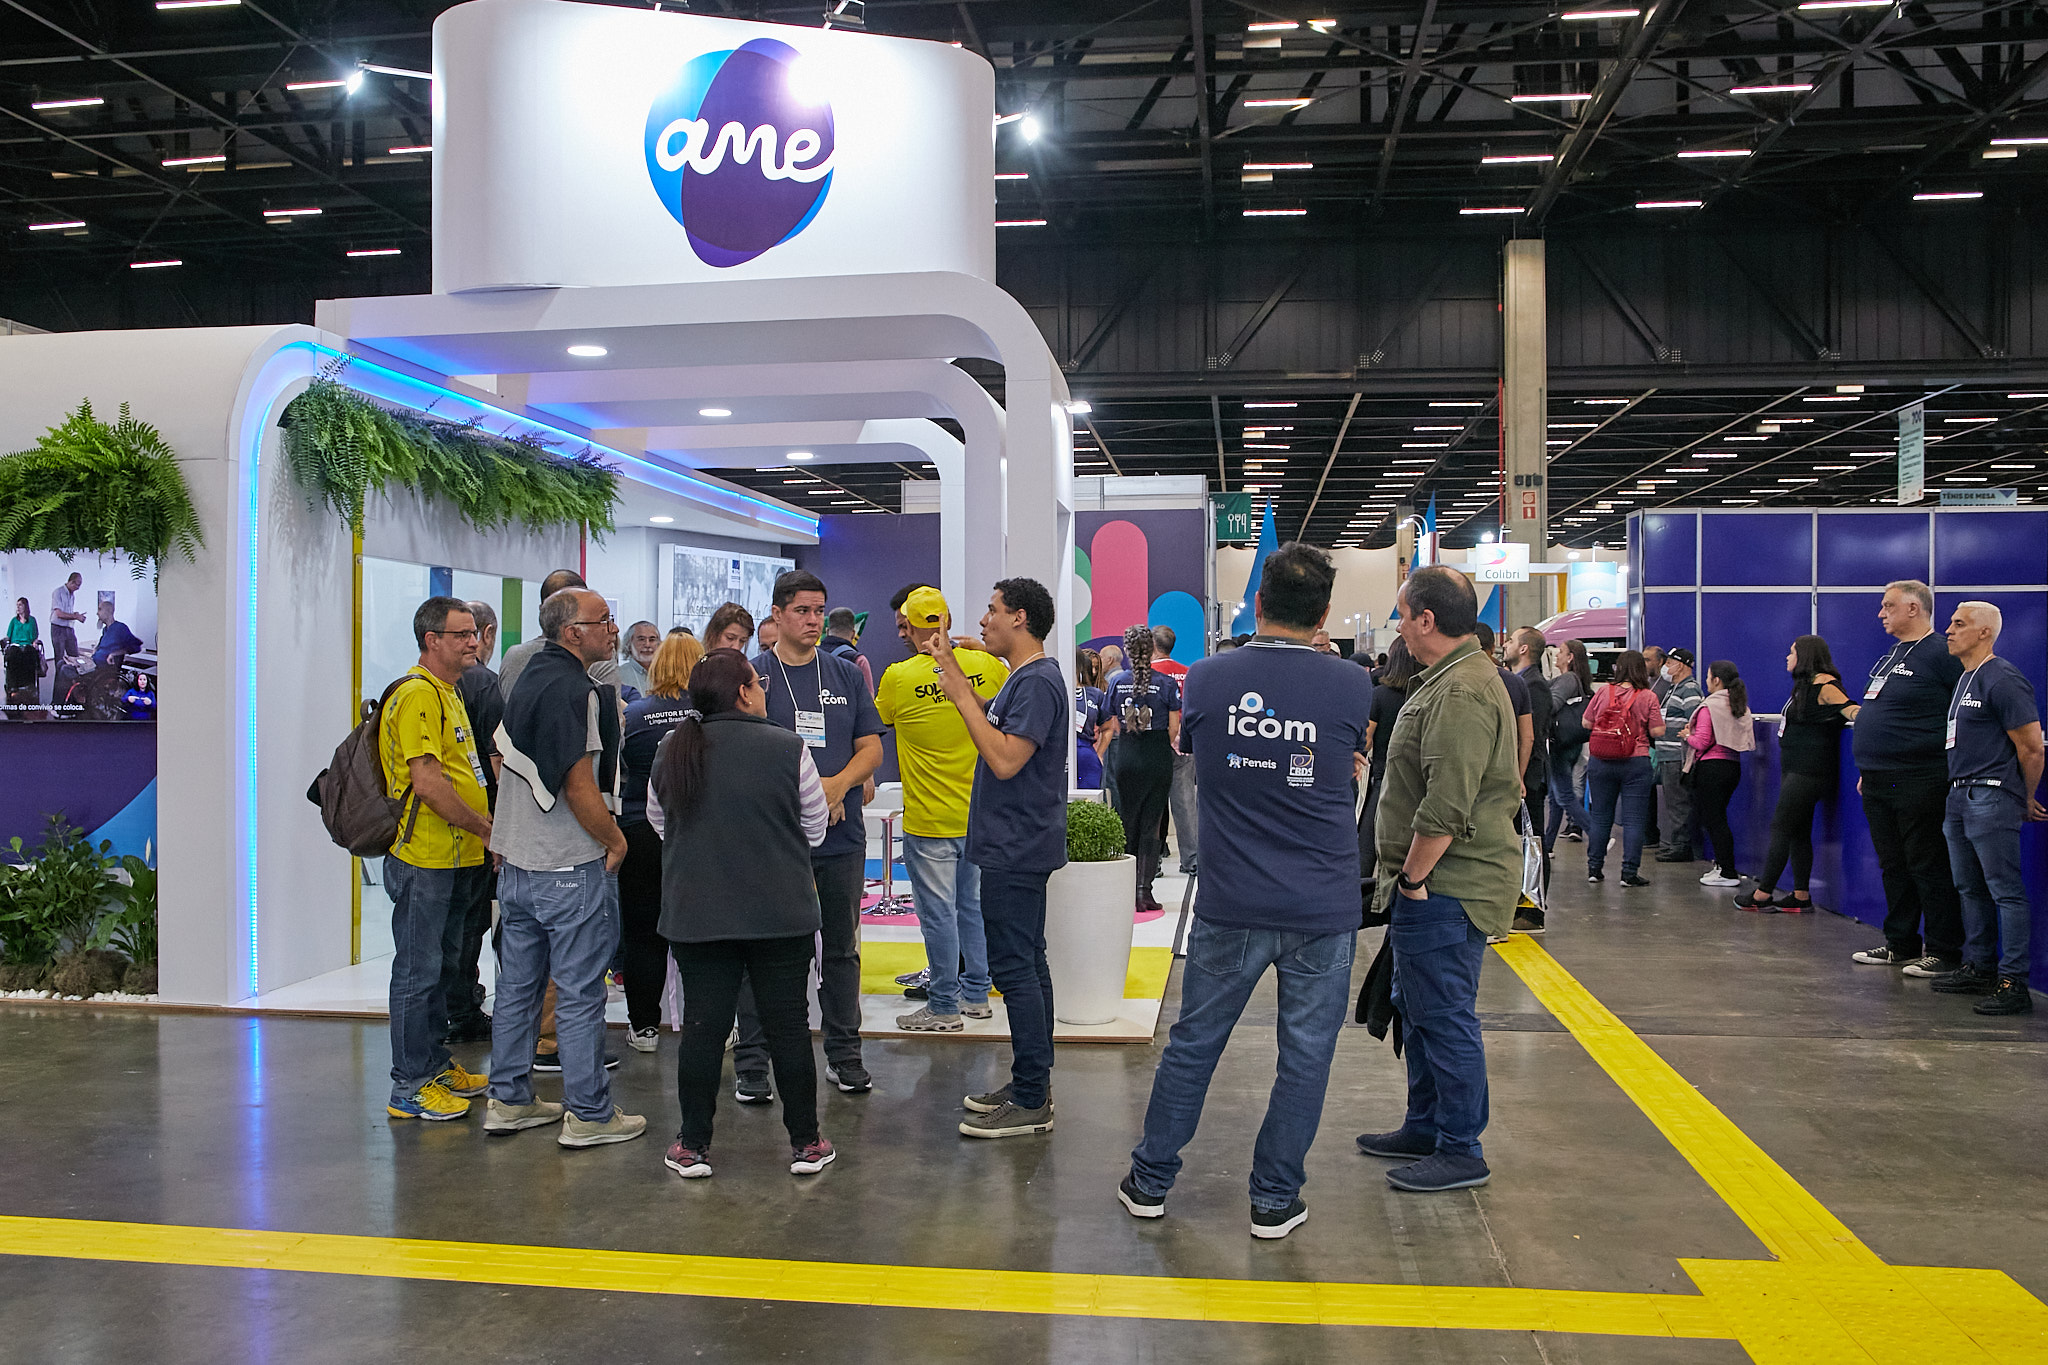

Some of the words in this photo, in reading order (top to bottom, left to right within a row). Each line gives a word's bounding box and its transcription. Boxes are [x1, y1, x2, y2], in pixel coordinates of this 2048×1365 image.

[655, 118, 835, 184] ame
[1942, 491, 1963, 500] TÊNIS
[1485, 569, 1520, 579] Colibri
[18, 703, 27, 711] de
[62, 703, 85, 711] coloca.
[643, 710, 678, 721] TRADUTOR
[1228, 704, 1317, 743] icom
[1242, 757, 1277, 770] Feneis
[1290, 767, 1313, 777] CBDS
